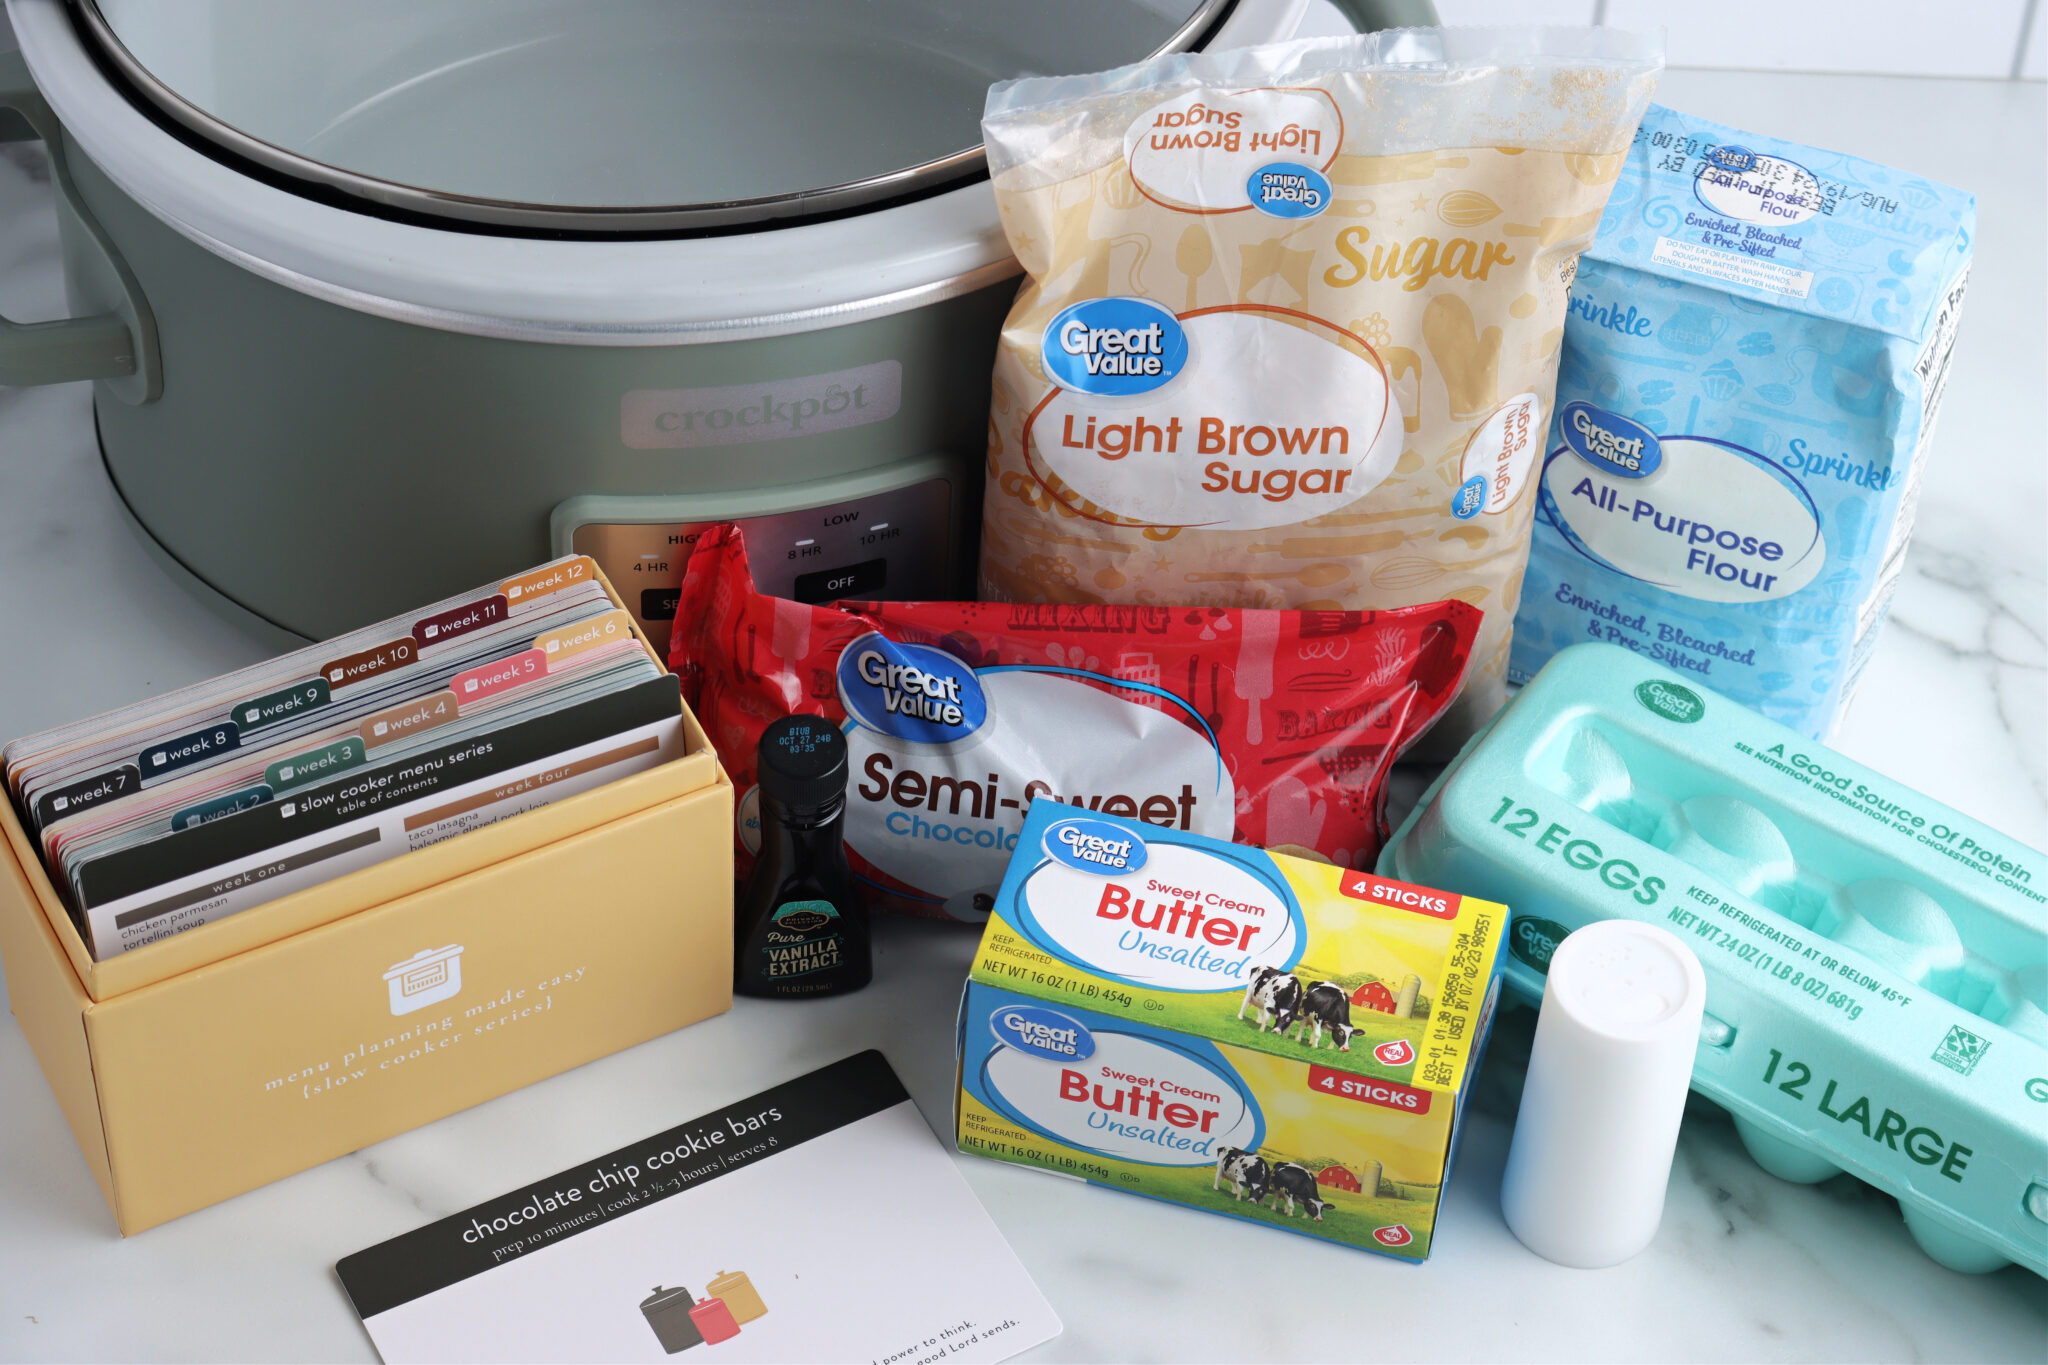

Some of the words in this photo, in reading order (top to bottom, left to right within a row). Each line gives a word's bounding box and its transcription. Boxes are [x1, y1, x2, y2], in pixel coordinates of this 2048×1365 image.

[1153, 103, 1242, 129] Sugar
[1151, 131, 1241, 152] Brown
[1249, 124, 1320, 155] Light
[1760, 200, 1800, 220] Flour
[1685, 212, 1742, 237] Enriched,
[1745, 225, 1803, 250] Bleached
[1702, 231, 1711, 243] &
[1713, 233, 1776, 258] Pre-Sifted
[1323, 226, 1515, 291] Sugar
[1060, 322, 1164, 355] Great
[1082, 347, 1163, 377] Value
[655, 383, 869, 432] crockpot
[1062, 415, 1183, 459] Light
[1196, 416, 1349, 456] Brown
[1497, 408, 1518, 462] Brown
[1514, 400, 1532, 452] Sugar
[1572, 409, 1646, 460] Great
[1585, 434, 1641, 473] Value
[1782, 438, 1901, 492] Sprinkle
[1201, 461, 1351, 501] Sugar
[1492, 462, 1511, 505] Light
[824, 511, 860, 528] LOW
[1571, 477, 1784, 562] All-Purpose
[787, 549, 797, 560] 8
[800, 545, 822, 559] HR
[859, 535, 876, 546] 10
[878, 527, 900, 543] HR
[525, 574, 563, 593] week
[566, 563, 583, 580] 12
[633, 562, 643, 572] 4
[647, 562, 669, 573] HR
[827, 576, 855, 591] OFF
[1687, 549, 1778, 593] Flour
[441, 613, 480, 633] week
[484, 603, 498, 619] 11
[1555, 583, 1652, 638] Enriched,
[1657, 613, 1756, 667] Bleached
[562, 630, 601, 651] week
[606, 622, 617, 634] 6
[1587, 619, 1602, 638] &
[1605, 624, 1712, 675] Pre-Sifted
[346, 656, 386, 678] week
[390, 645, 410, 661] 10
[481, 667, 520, 688] week
[525, 659, 536, 674] 5
[857, 651, 963, 704] Great
[262, 694, 303, 718] week
[306, 687, 318, 702] 9
[883, 688, 965, 725] Value
[1645, 681, 1695, 713] Great
[1652, 697, 1689, 719] Value
[390, 711, 430, 732] week
[435, 701, 447, 716] 4
[169, 737, 210, 761] week
[215, 731, 227, 745] 8
[779, 736, 795, 745] OCT
[800, 735, 810, 745] 27
[297, 752, 338, 776] week
[342, 746, 352, 760] 3
[301, 794, 334, 813] slow
[340, 774, 394, 800] cooker
[399, 758, 444, 782] menu
[449, 742, 494, 764] series
[71, 784, 113, 806] week
[115, 776, 127, 790] 7
[337, 799, 366, 816] table
[370, 791, 383, 805] of
[386, 776, 438, 799] contents
[495, 779, 533, 799] week
[538, 768, 571, 785] four
[408, 827, 434, 842] taco
[436, 812, 479, 833] lasagna
[1734, 741, 1755, 756] SEE
[1754, 752, 1812, 785] NUTRITION
[1812, 781, 1890, 825] INFORMATION
[1891, 821, 1916, 837] FOR
[1916, 834, 1993, 878] CHOLESTEROL
[1994, 873, 2047, 905] CONTENT
[1767, 743, 1785, 758] A
[1791, 753, 1853, 791] Good
[1852, 784, 1927, 829] Source
[1930, 824, 1960, 844] Of
[1958, 837, 2033, 884] Protein
[1057, 825, 1132, 859] Great
[1072, 845, 1126, 869] Value
[1489, 797, 1540, 840] 12
[1535, 822, 1667, 906] EGGS
[1146, 879, 1201, 901] Sweet
[1205, 893, 1265, 917] Cream
[1353, 881, 1366, 893] 4
[1372, 885, 1447, 913] STICKS
[121, 916, 167, 940] chicken
[170, 896, 228, 925] parmesan
[1096, 883, 1261, 951] Butter
[123, 928, 174, 951] tortellini
[177, 917, 206, 937] soup
[767, 932, 806, 944] Pure
[768, 938, 837, 963] VANILLA
[993, 934, 1014, 945] KEEP
[1686, 885, 1720, 907] KEEP
[1718, 902, 1803, 953] REFRIGERATED
[1802, 947, 1821, 961] AT
[1820, 956, 1839, 971] OR
[1838, 965, 1882, 993] BELOW
[769, 951, 839, 976] EXTRACT
[989, 943, 1052, 965] REFRIGERATED
[1118, 930, 1251, 979] Unsalted
[982, 959, 1005, 973] NET
[1006, 965, 1026, 979] WT
[1031, 971, 1045, 984] 16
[1047, 974, 1064, 988] OZ
[1065, 979, 1076, 993] (1
[1080, 982, 1100, 999] LB)
[1102, 988, 1132, 1007] 454g
[1459, 949, 1482, 996] 07/02/23
[1455, 1000, 1469, 1012] BY
[265, 1061, 330, 1092] menu
[344, 1015, 454, 1067] planning
[465, 987, 527, 1019] made
[537, 966, 587, 992] easy
[1448, 1015, 1466, 1040] USED
[1444, 1044, 1458, 1056] IF
[1436, 1062, 1454, 1086] BEST
[1059, 1068, 1219, 1133] Butter
[1762, 1047, 1811, 1101] 12
[1817, 1079, 1973, 1184] LARGE
[1087, 1111, 1216, 1157] Unsalted
[463, 1185, 583, 1244] chocolate
[588, 1162, 641, 1195] chip
[647, 1128, 727, 1172] cookie
[726, 1105, 783, 1138] bars
[492, 1238, 524, 1262] prep
[545, 1208, 599, 1239] minutes
[607, 1191, 641, 1213] cook
[642, 1188, 651, 1201] 2
[683, 1159, 719, 1183] hours
[727, 1141, 767, 1165] serves
[768, 1136, 778, 1147] 8
